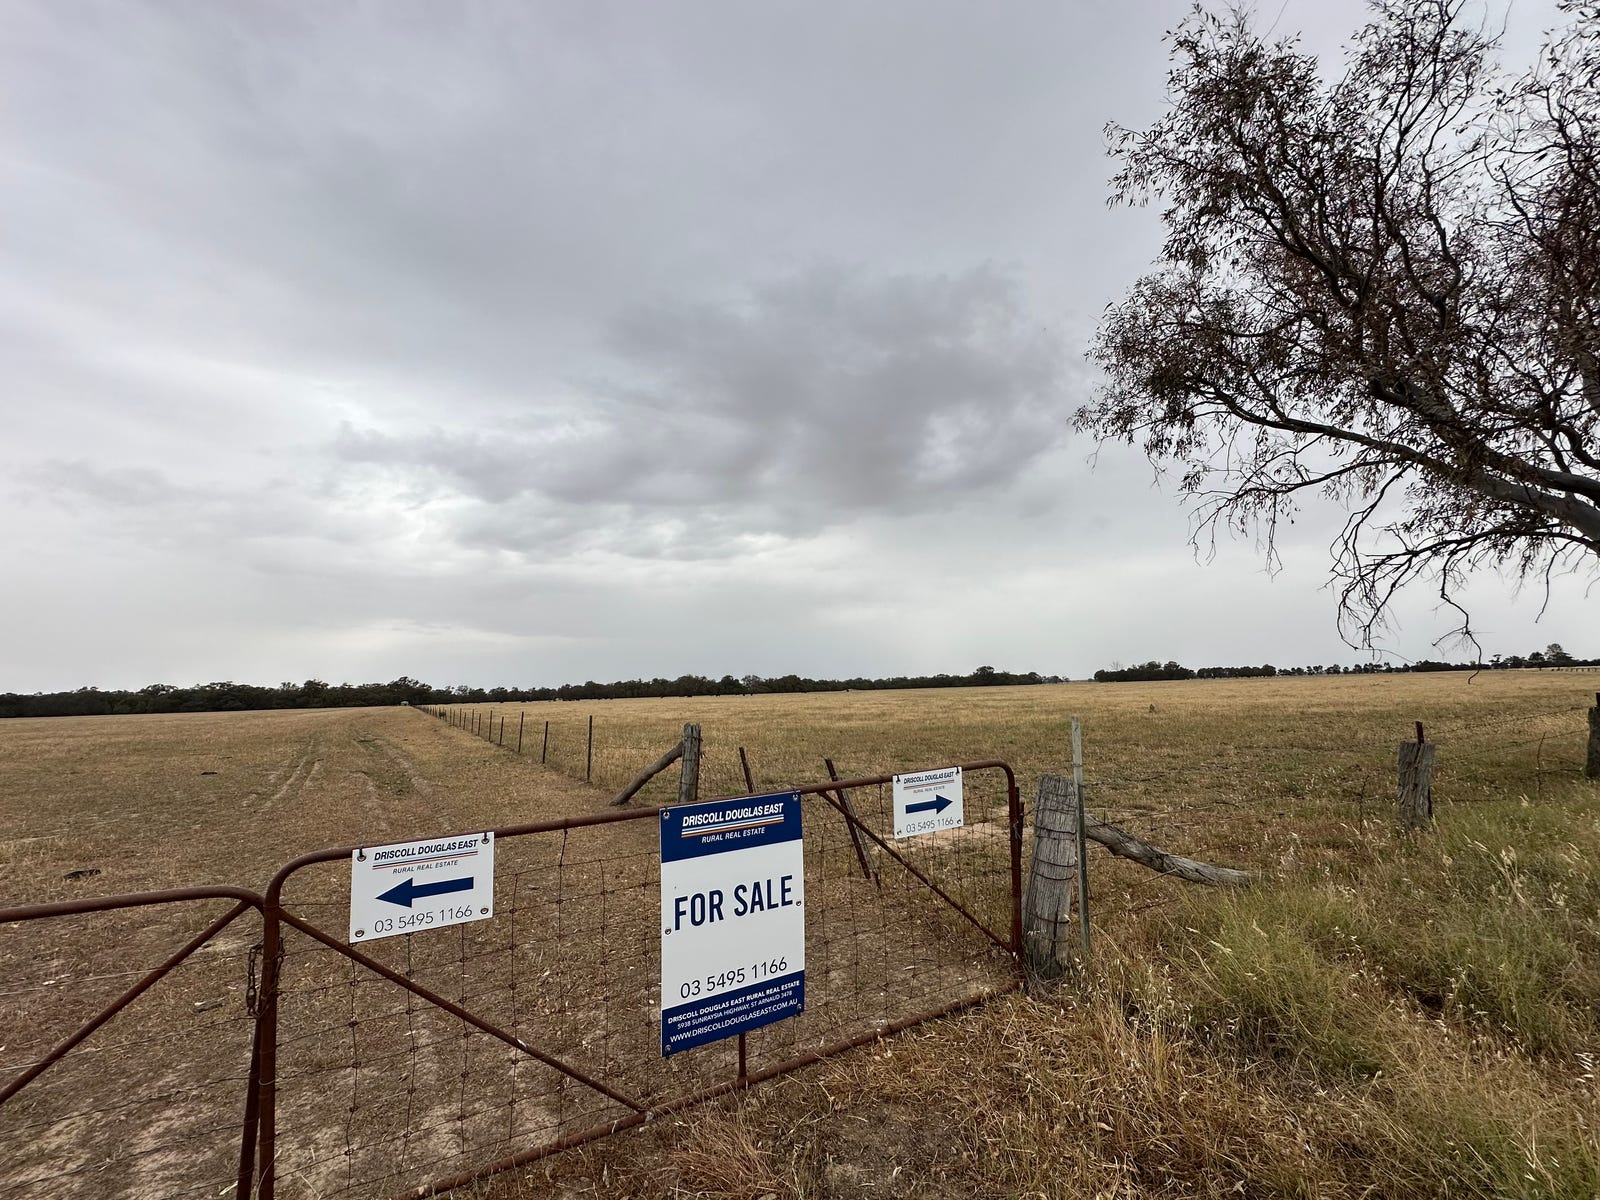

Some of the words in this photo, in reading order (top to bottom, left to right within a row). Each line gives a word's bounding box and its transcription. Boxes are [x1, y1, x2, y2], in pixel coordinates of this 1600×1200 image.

[904, 776, 924, 784] DRISCOLL
[924, 773, 944, 781] DOUGLAS
[682, 812, 724, 826] DRISCOLL
[726, 806, 763, 820] DOUGLAS
[764, 803, 784, 814] EAST
[906, 824, 916, 833] 03
[918, 820, 935, 831] 5495
[938, 817, 954, 827] 1166
[702, 834, 724, 844] RURAL
[725, 831, 741, 840] REAL
[743, 827, 766, 836] ESTATE
[374, 848, 416, 861] DRISCOLL
[418, 842, 456, 855] DOUGLAS
[458, 840, 478, 850] EAST
[392, 866, 414, 874] RURAL
[435, 860, 458, 868] ESTATE
[674, 889, 724, 931] FOR
[734, 875, 793, 916] SALE
[374, 918, 393, 933] 03
[398, 912, 434, 928] 5495
[440, 905, 472, 920] 1166
[680, 980, 700, 998] 03
[706, 968, 745, 991] 5495
[752, 956, 787, 978] 1166
[668, 1010, 698, 1024] DRISCOLL
[700, 1002, 730, 1015] DOUGLAS
[730, 996, 746, 1006] EAST
[746, 992, 765, 1002] RURAL
[766, 986, 780, 996] REAL
[781, 980, 800, 991] ESTATE
[678, 1022, 691, 1030] 5938
[692, 1012, 723, 1026] SUNRAYSIA
[758, 994, 780, 1006] ARNAUD
[670, 998, 798, 1043] WWW.DRISCOLLDOUGLASEAST.COM.AU
